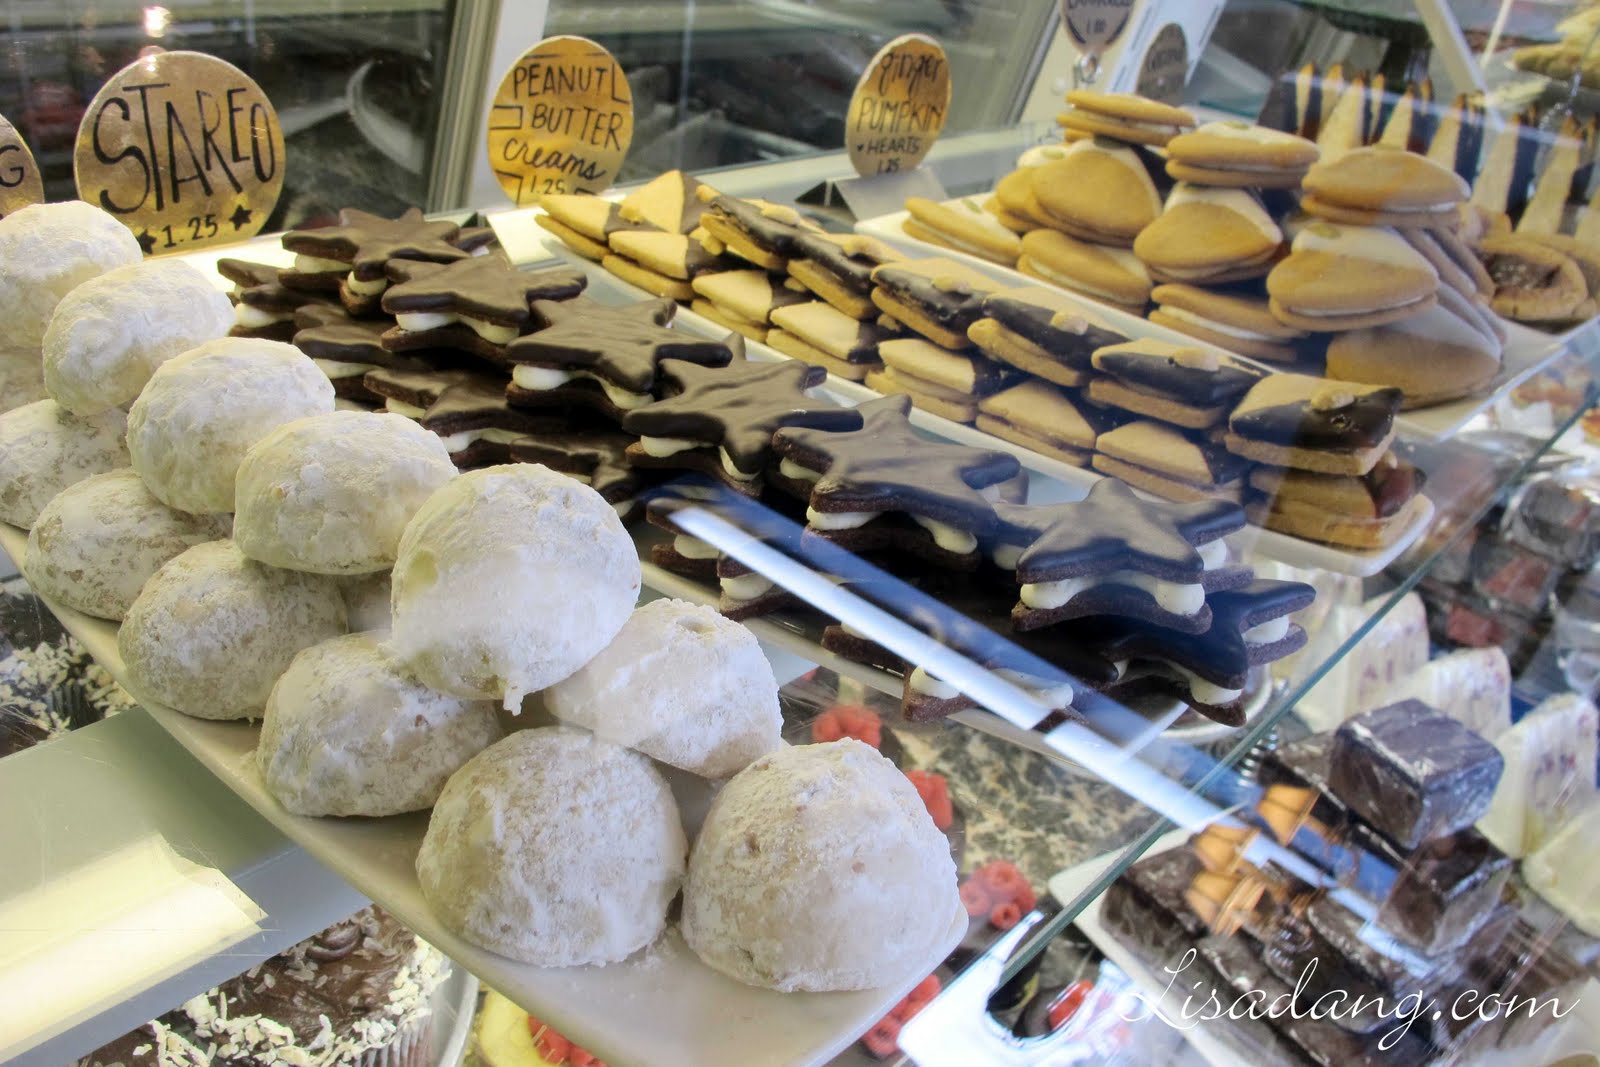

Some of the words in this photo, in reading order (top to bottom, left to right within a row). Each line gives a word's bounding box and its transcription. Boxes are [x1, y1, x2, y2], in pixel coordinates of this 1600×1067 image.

[513, 63, 608, 98] PEANUT
[531, 103, 624, 151] BUTTER
[856, 97, 943, 133] PUMPKIN
[92, 83, 276, 214] STAREO
[866, 135, 922, 155] HEARTS
[161, 213, 219, 248] 1.25
